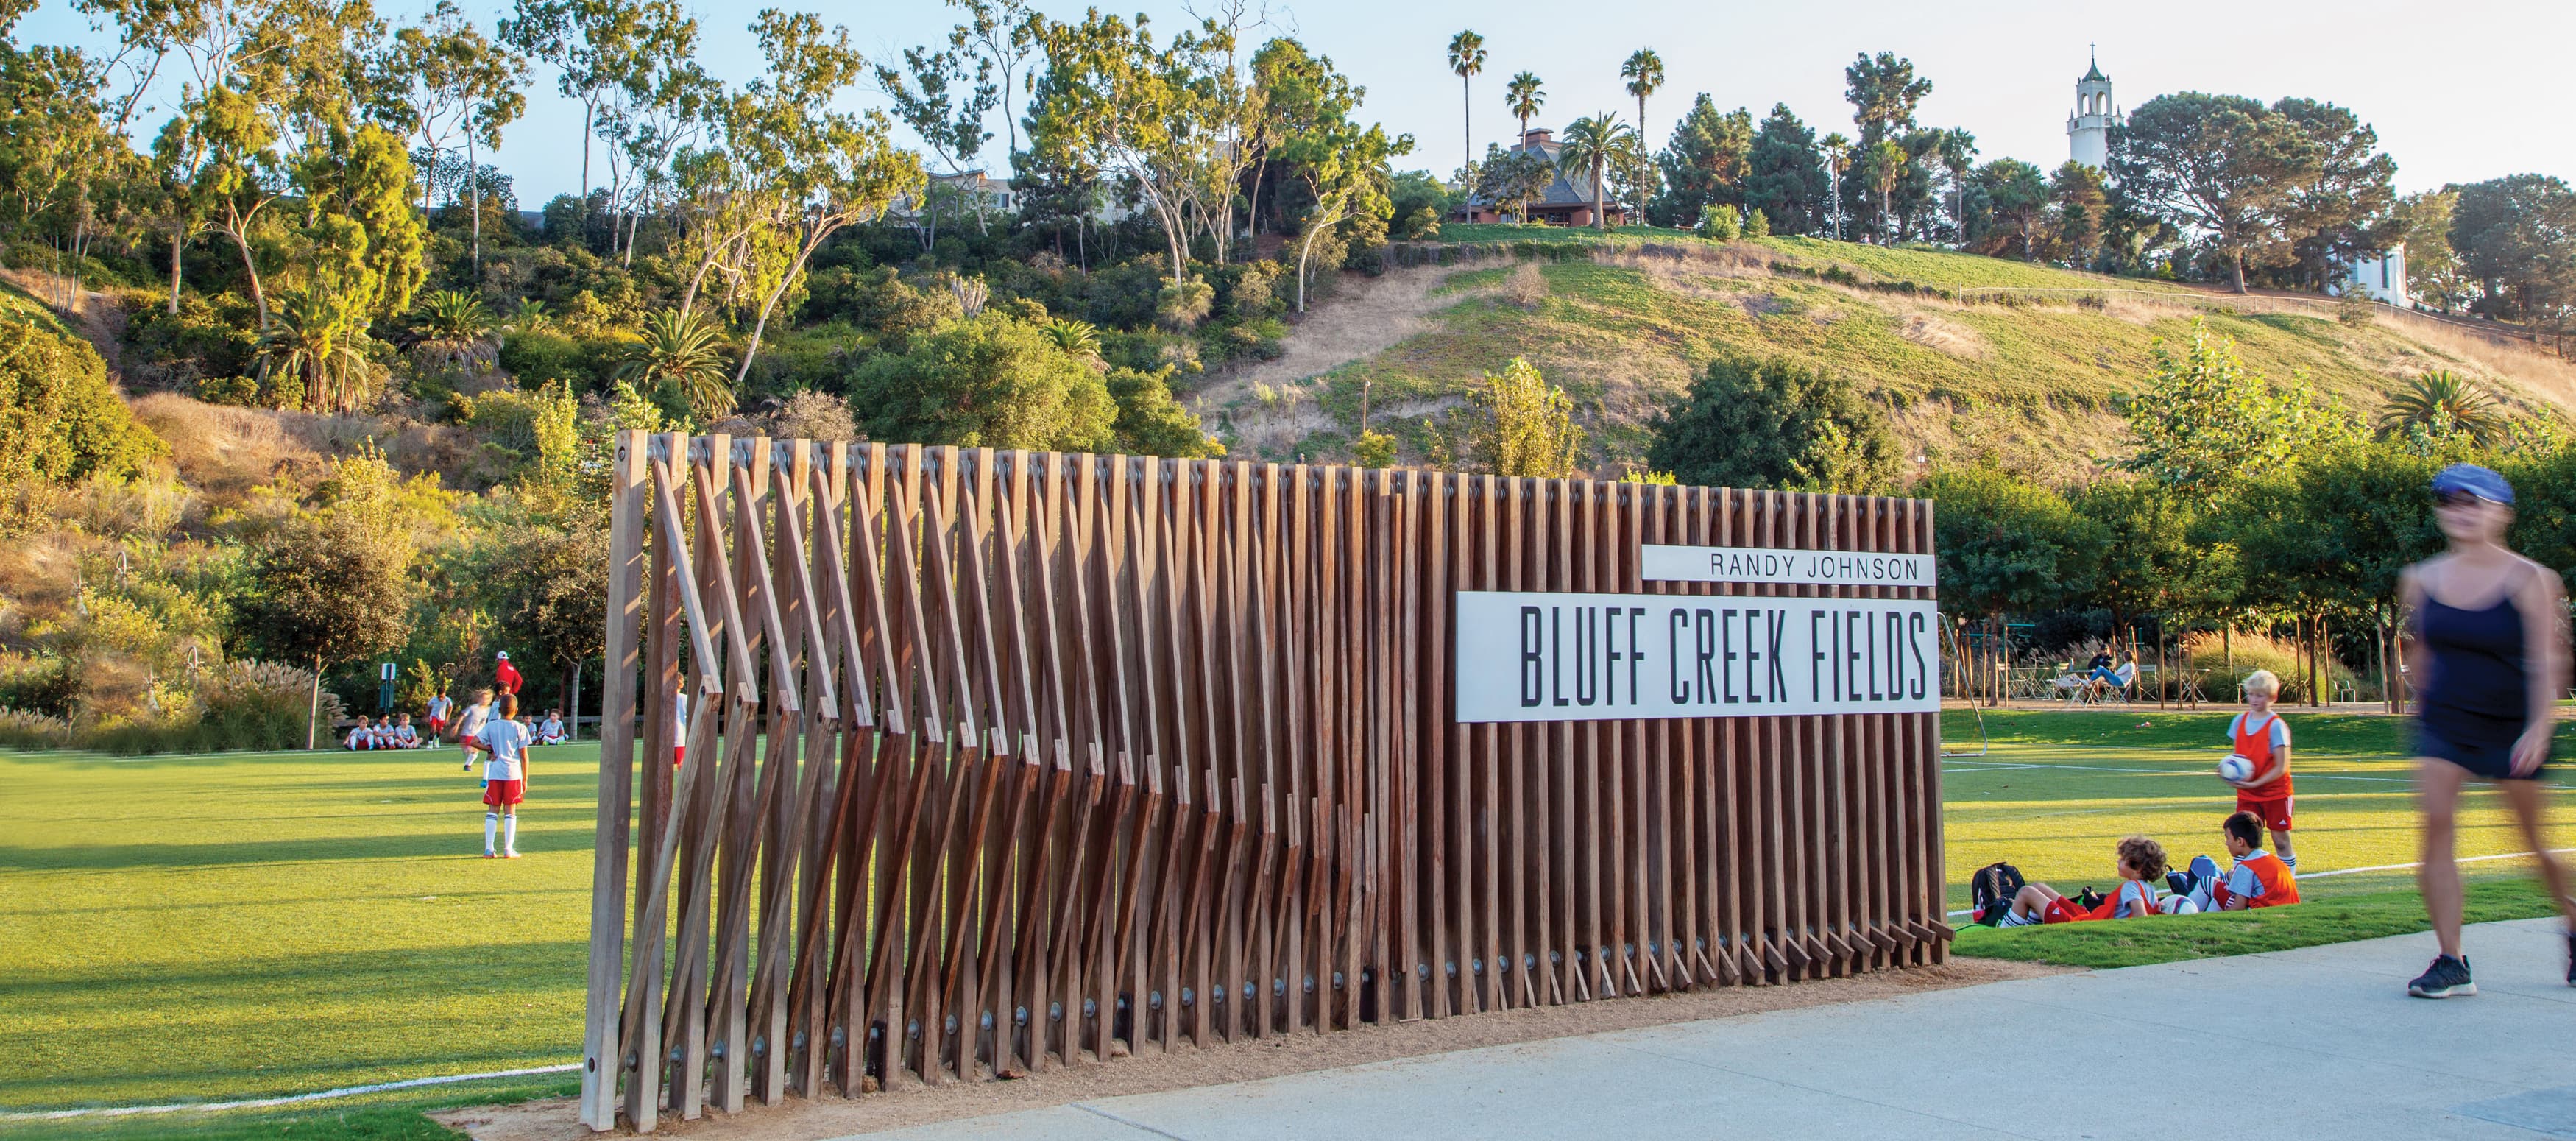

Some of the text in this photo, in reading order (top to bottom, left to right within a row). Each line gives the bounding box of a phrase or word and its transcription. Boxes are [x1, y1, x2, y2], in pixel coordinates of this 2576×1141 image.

[1710, 553, 1918, 580] RANDY JOHNSON
[1521, 606, 1926, 707] BLUFF CREEK FIELDS
